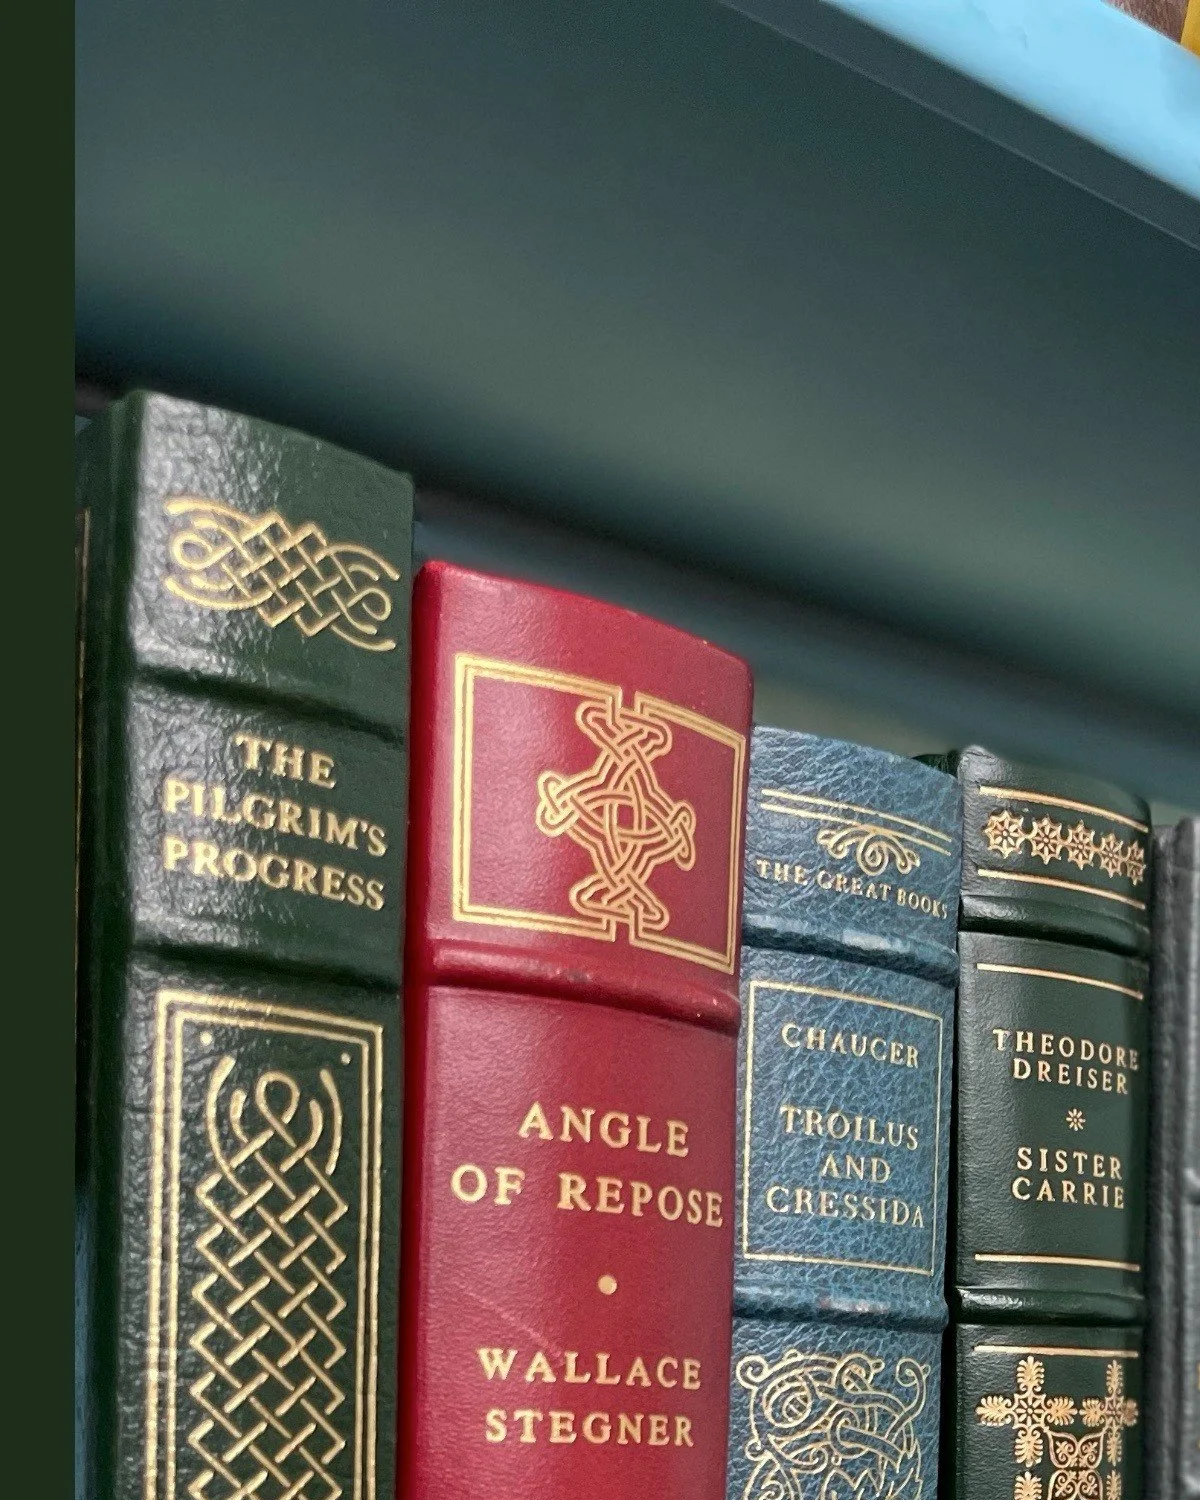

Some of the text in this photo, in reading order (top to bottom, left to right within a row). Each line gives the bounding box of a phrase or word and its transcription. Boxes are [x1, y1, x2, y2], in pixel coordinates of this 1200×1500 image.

[235, 733, 336, 789] THE
[164, 777, 387, 857] PILGRIM'S
[163, 835, 385, 911] PROGRESS
[756, 859, 948, 919] THE GREAT BOOKS
[781, 1022, 919, 1069] CHAUCER
[992, 1028, 1138, 1071] THEODORE
[1013, 1057, 1128, 1095] DREISER
[518, 1101, 689, 1157] ANGLE
[779, 1104, 919, 1150] TROILUS
[820, 1153, 891, 1183] AND
[1017, 1146, 1122, 1180] SISTER
[451, 1164, 723, 1228] OF REPOSE
[766, 1185, 925, 1229] CRESSIDA
[1011, 1176, 1124, 1209] CARRIE
[477, 1347, 701, 1390] WALLACE
[484, 1408, 694, 1447] STEGNER
